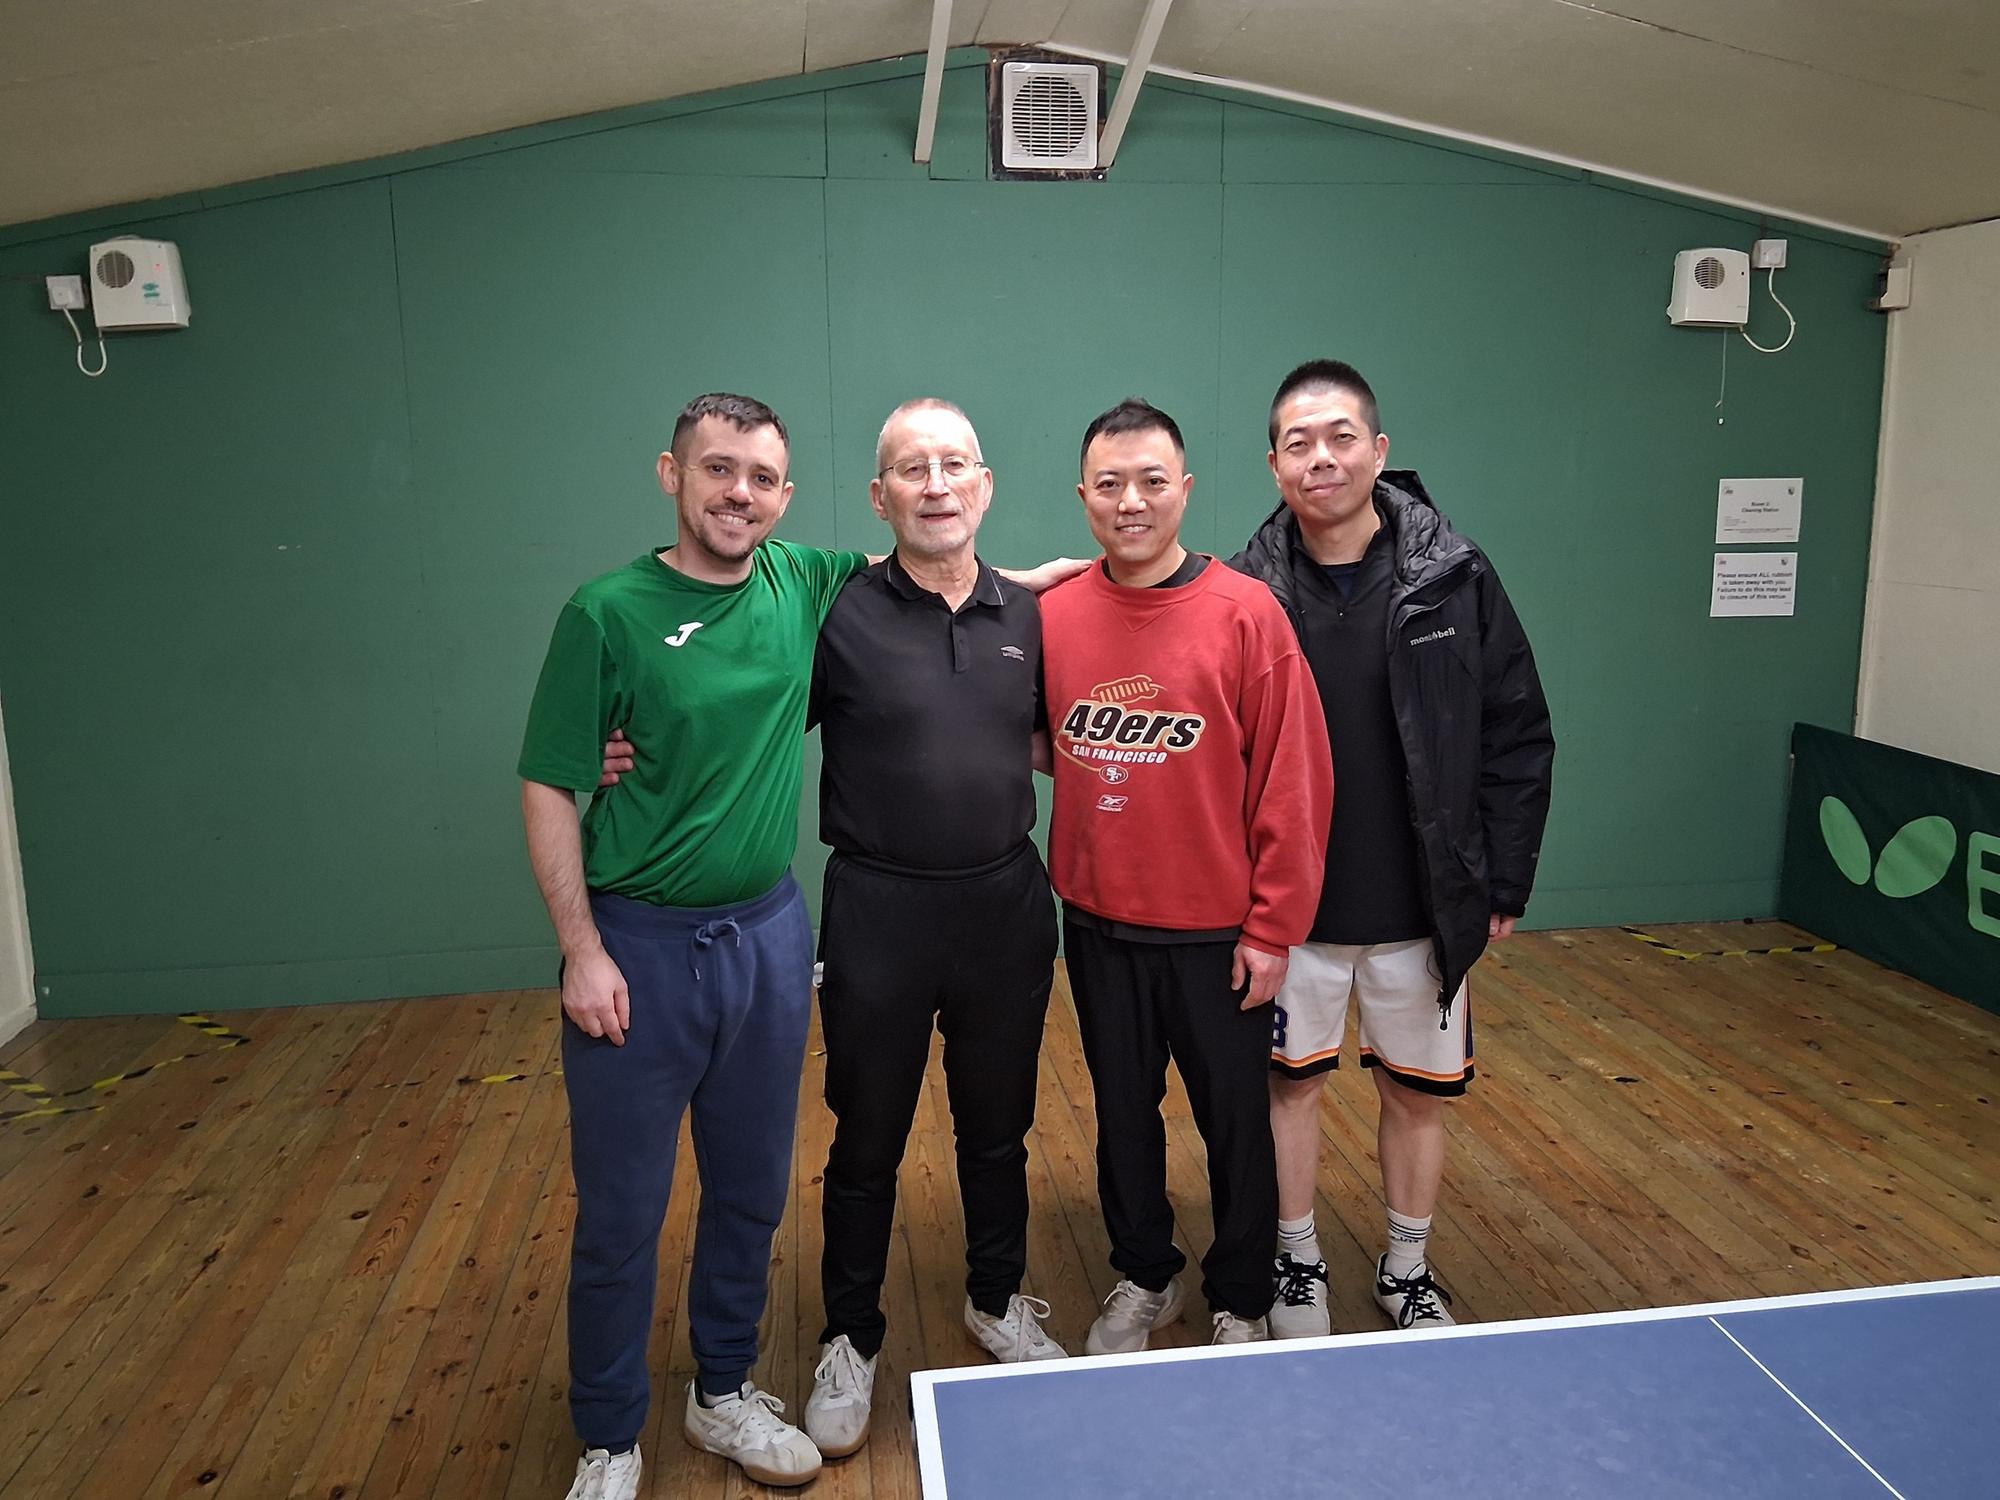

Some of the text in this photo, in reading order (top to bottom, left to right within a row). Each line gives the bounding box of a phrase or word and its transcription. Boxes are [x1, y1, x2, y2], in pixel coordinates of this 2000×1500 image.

[1062, 703, 1204, 749] 49ers
[1072, 744, 1168, 764] SAN FRANCISCO
